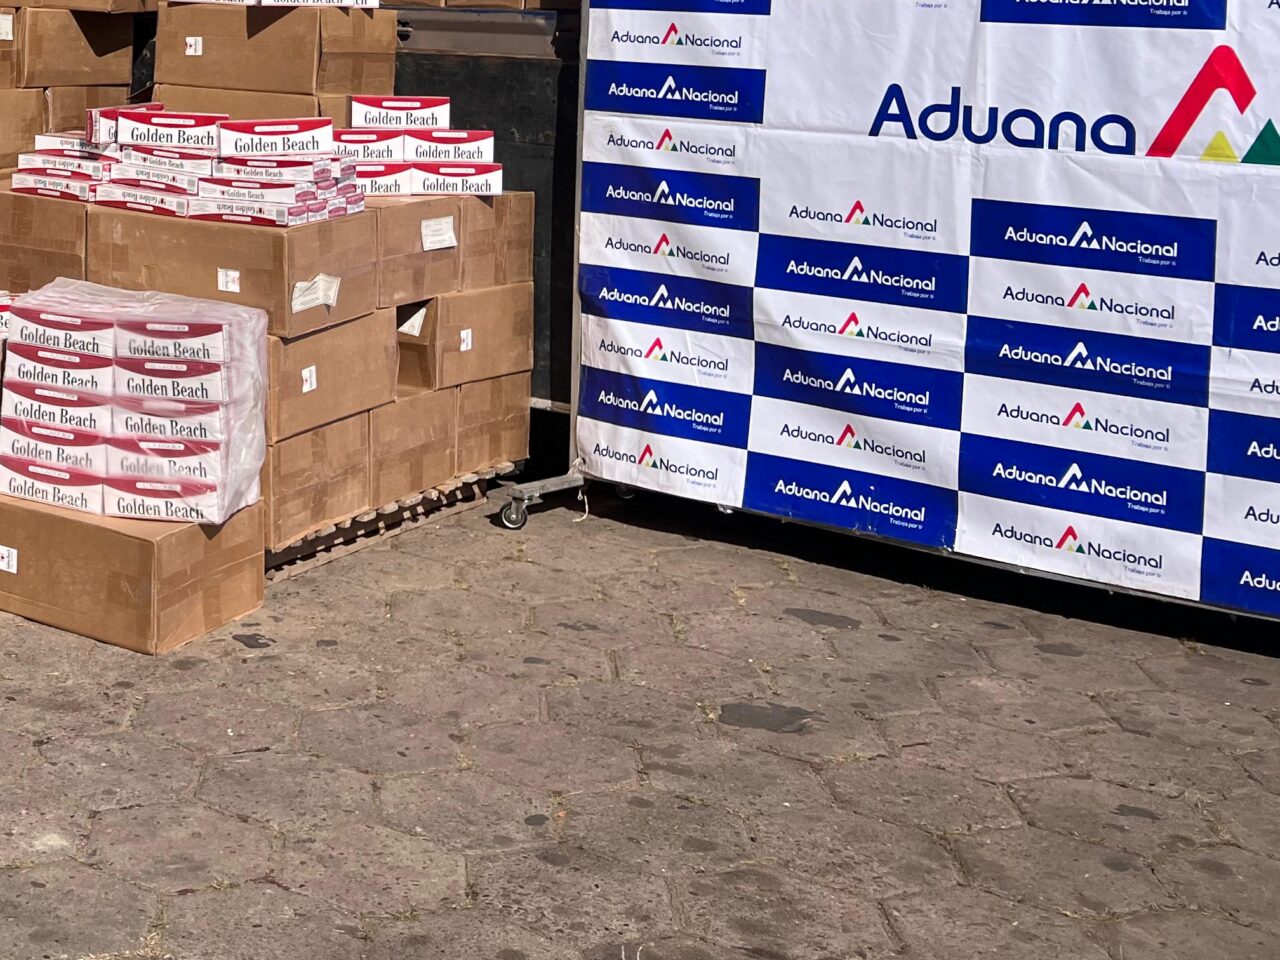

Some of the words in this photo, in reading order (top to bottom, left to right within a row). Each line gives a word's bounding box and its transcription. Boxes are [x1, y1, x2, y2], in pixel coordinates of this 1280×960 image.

[611, 31, 660, 45] Aduana
[685, 34, 741, 48] Nacional
[609, 83, 656, 98] Aduana
[682, 88, 738, 103] Nacional
[365, 111, 402, 125] Golden
[406, 112, 437, 125] Beach
[868, 83, 1136, 155] Aduana
[131, 127, 173, 143] Golden
[177, 129, 214, 146] Beach
[235, 137, 278, 153] Golden
[282, 136, 319, 151] Beach
[607, 134, 654, 150] Aduana
[680, 141, 735, 157] Nacional
[149, 158, 167, 167] Golden
[363, 145, 392, 158] Beach
[416, 145, 449, 158] Golden
[454, 146, 482, 159] Beach
[244, 168, 263, 177] Golden
[265, 169, 283, 177] Beach
[423, 178, 457, 192] Golden
[461, 180, 491, 192] Beach
[227, 190, 246, 198] Golden
[248, 191, 264, 199] Beach
[371, 180, 400, 193] Beach
[606, 185, 652, 202] Aduana
[676, 193, 734, 211] Nacional
[789, 205, 842, 222] Aduana
[873, 214, 937, 232] Nacional
[605, 237, 651, 254] Aduana
[677, 247, 729, 265] Nacional
[1004, 226, 1067, 246] Aduana
[1102, 236, 1177, 257] Nacional
[787, 260, 841, 279] Aduana
[871, 270, 935, 291] Nacional
[599, 287, 648, 306] Aduana
[674, 299, 729, 317] Nacional
[1003, 286, 1064, 306] Aduana
[1100, 298, 1175, 319] Nacional
[20, 326, 59, 346] Golden
[64, 332, 99, 353] Beach
[782, 315, 837, 334] Aduana
[867, 326, 932, 347] Nacional
[129, 340, 169, 357] Golden
[174, 342, 210, 359] Beach
[599, 339, 643, 359] Aduana
[670, 350, 728, 371] Nacional
[999, 344, 1062, 366] Aduana
[1096, 358, 1172, 380] Nacional
[18, 363, 58, 384] Golden
[63, 370, 97, 389] Beach
[127, 378, 168, 396] Golden
[172, 381, 208, 398] Beach
[783, 368, 834, 391] Aduana
[862, 382, 929, 405] Nacional
[15, 402, 56, 423] Golden
[60, 409, 96, 429] Beach
[598, 390, 639, 412] Aduana
[664, 403, 723, 426] Nacional
[126, 416, 166, 435] Golden
[170, 420, 207, 438] Beach
[997, 404, 1060, 425] Aduana
[1095, 419, 1169, 442] Nacional
[12, 439, 52, 460] Golden
[57, 447, 92, 468] Beach
[780, 424, 834, 445] Aduana
[864, 438, 926, 463] Nacional
[594, 443, 636, 464] Aduana
[660, 459, 718, 480] Nacional
[9, 477, 48, 501] Golden
[53, 486, 87, 508] Beach
[993, 463, 1056, 487] Aduana
[1091, 480, 1167, 506] Nacional
[775, 479, 829, 503] Aduana
[858, 497, 925, 521] Nacional
[992, 523, 1053, 548] Aduana
[1088, 542, 1162, 569] Nacional
